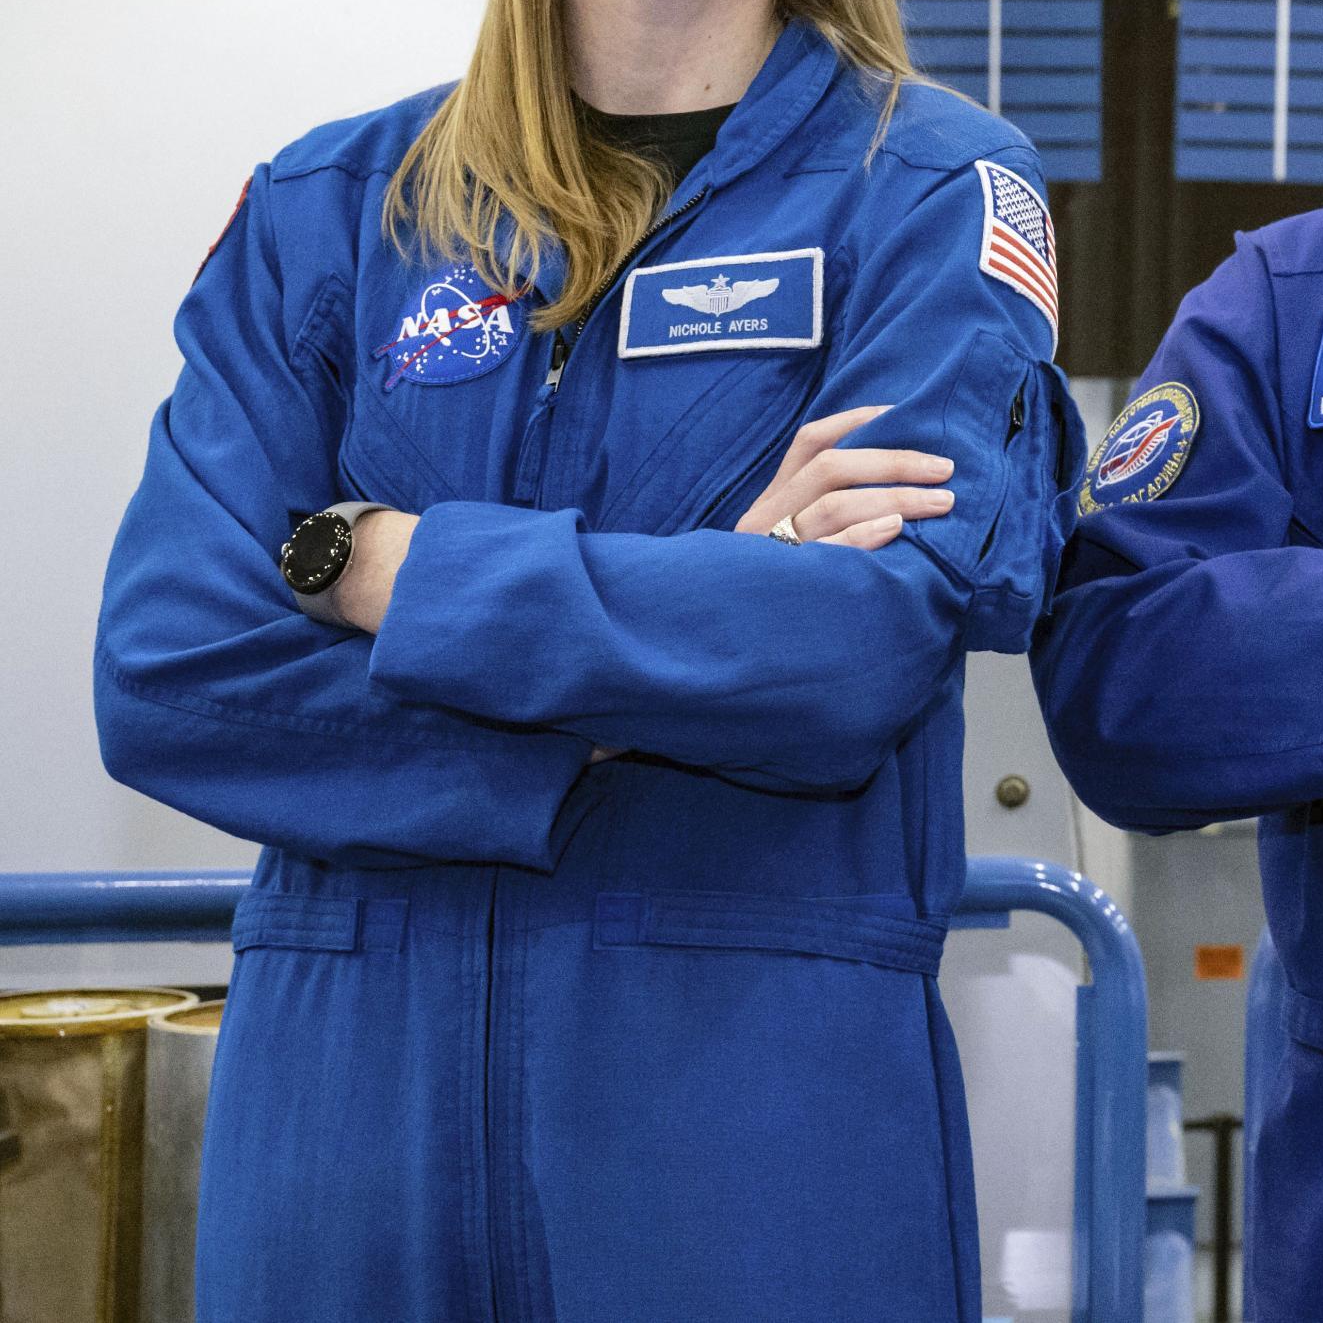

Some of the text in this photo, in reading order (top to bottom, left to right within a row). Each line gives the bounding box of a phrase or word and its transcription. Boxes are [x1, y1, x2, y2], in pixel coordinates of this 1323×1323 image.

[397, 303, 514, 342] NASA
[668, 318, 769, 338] NICHOLE AYERS
